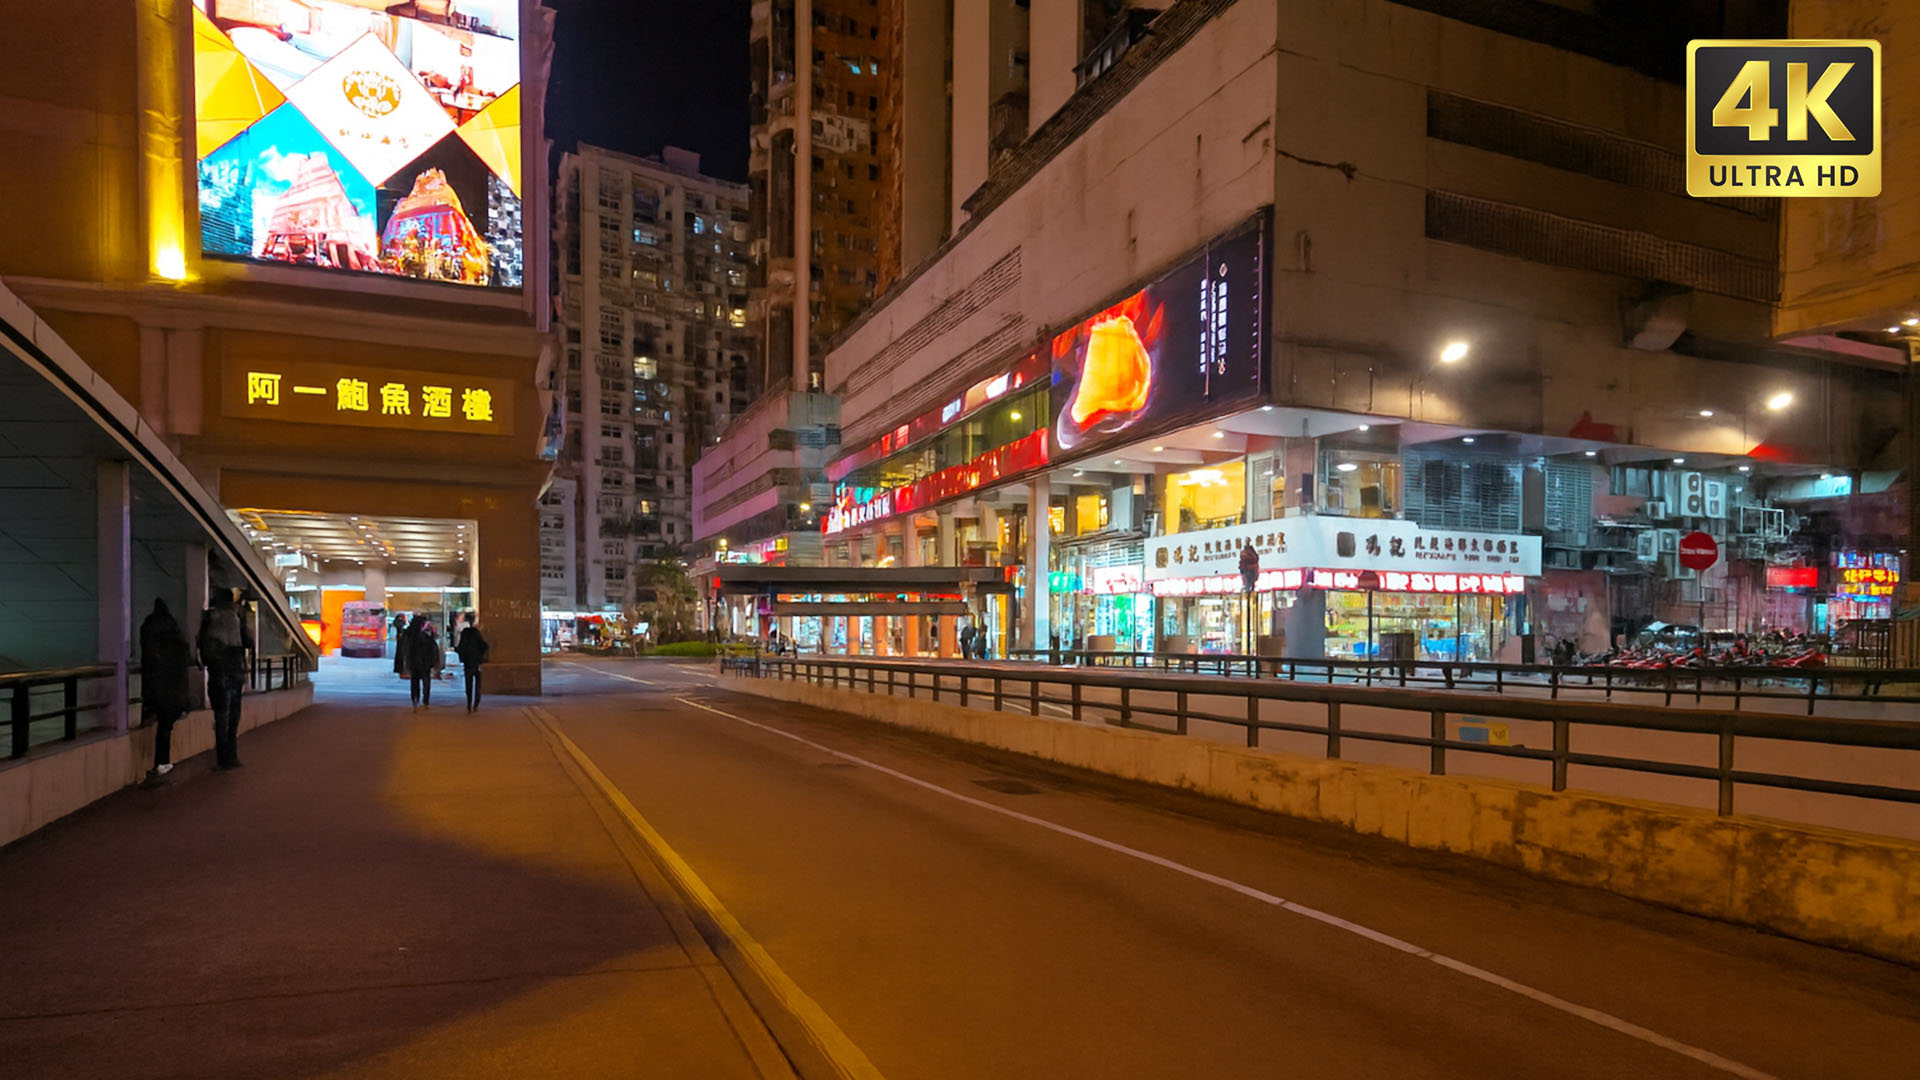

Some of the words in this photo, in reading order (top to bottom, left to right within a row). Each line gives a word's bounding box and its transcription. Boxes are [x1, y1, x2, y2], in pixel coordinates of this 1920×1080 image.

[247, 371, 493, 422] 阿一鮑魚酒樓
